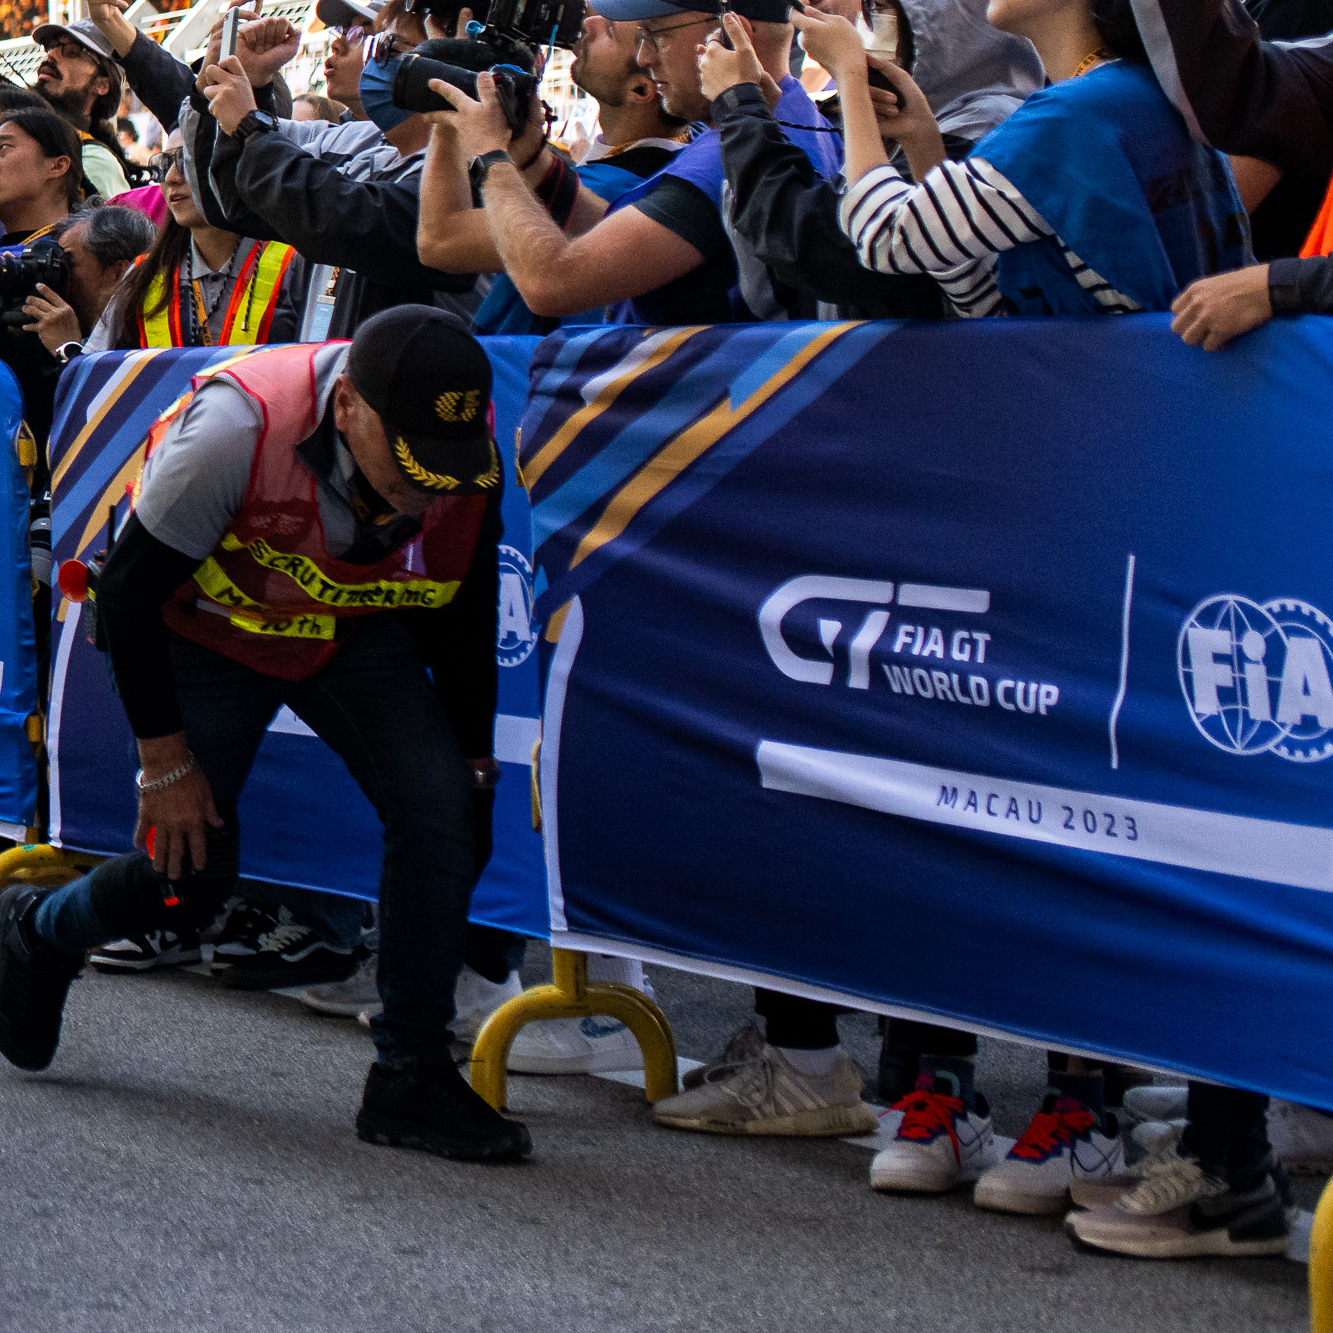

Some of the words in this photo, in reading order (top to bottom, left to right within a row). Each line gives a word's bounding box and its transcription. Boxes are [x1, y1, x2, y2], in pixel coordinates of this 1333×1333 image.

[892, 624, 945, 659] FIA
[950, 630, 992, 664] GT
[883, 664, 991, 708] WORLD
[996, 679, 1060, 715] CUP
[937, 785, 1044, 826] MACAU
[1061, 806, 1140, 843] 2023
